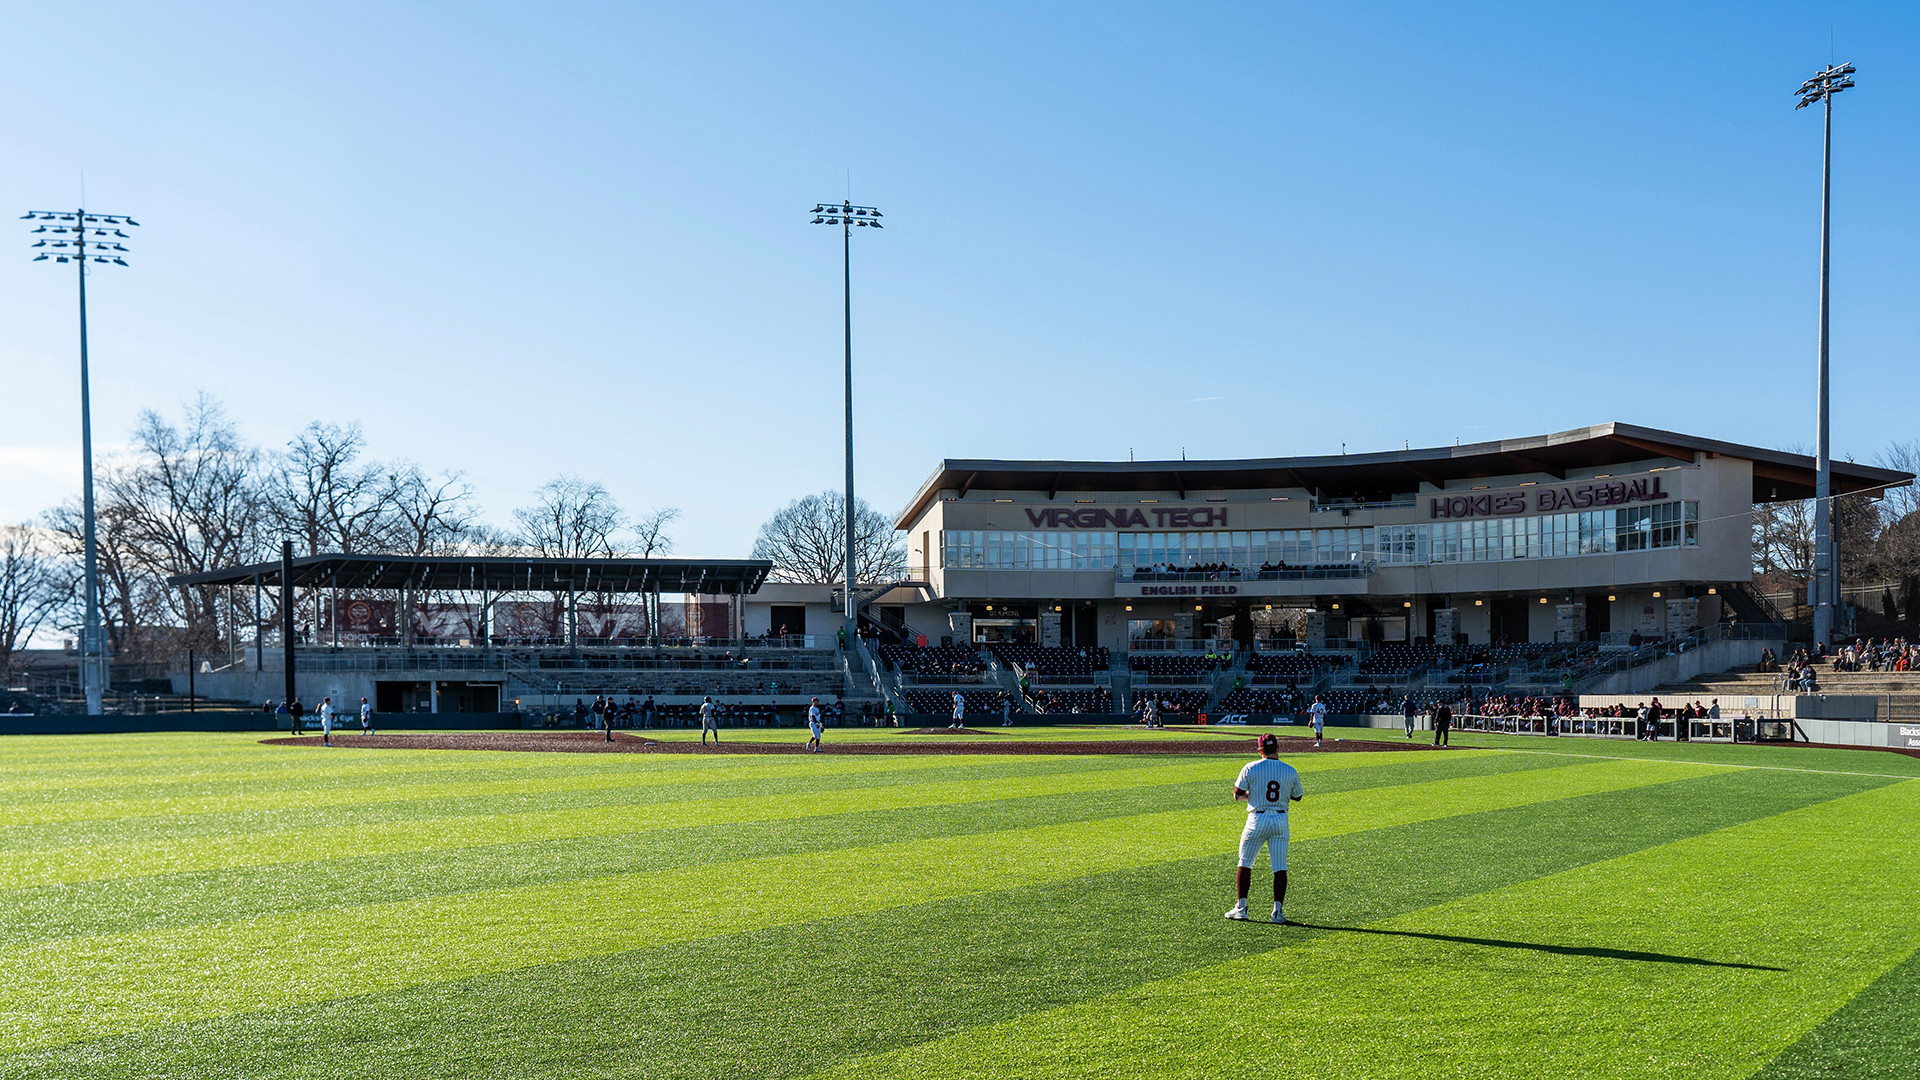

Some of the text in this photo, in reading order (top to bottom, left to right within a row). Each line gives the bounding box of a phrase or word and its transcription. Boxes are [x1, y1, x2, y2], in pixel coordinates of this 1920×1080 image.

[1430, 477, 1668, 519] HOKIES BASEBALL
[1024, 507, 1227, 529] VIRGINIA TECH
[1141, 585, 1238, 596] ENGLISH FIELD
[1217, 714, 1249, 724] ACC
[1265, 780, 1280, 802] 8
